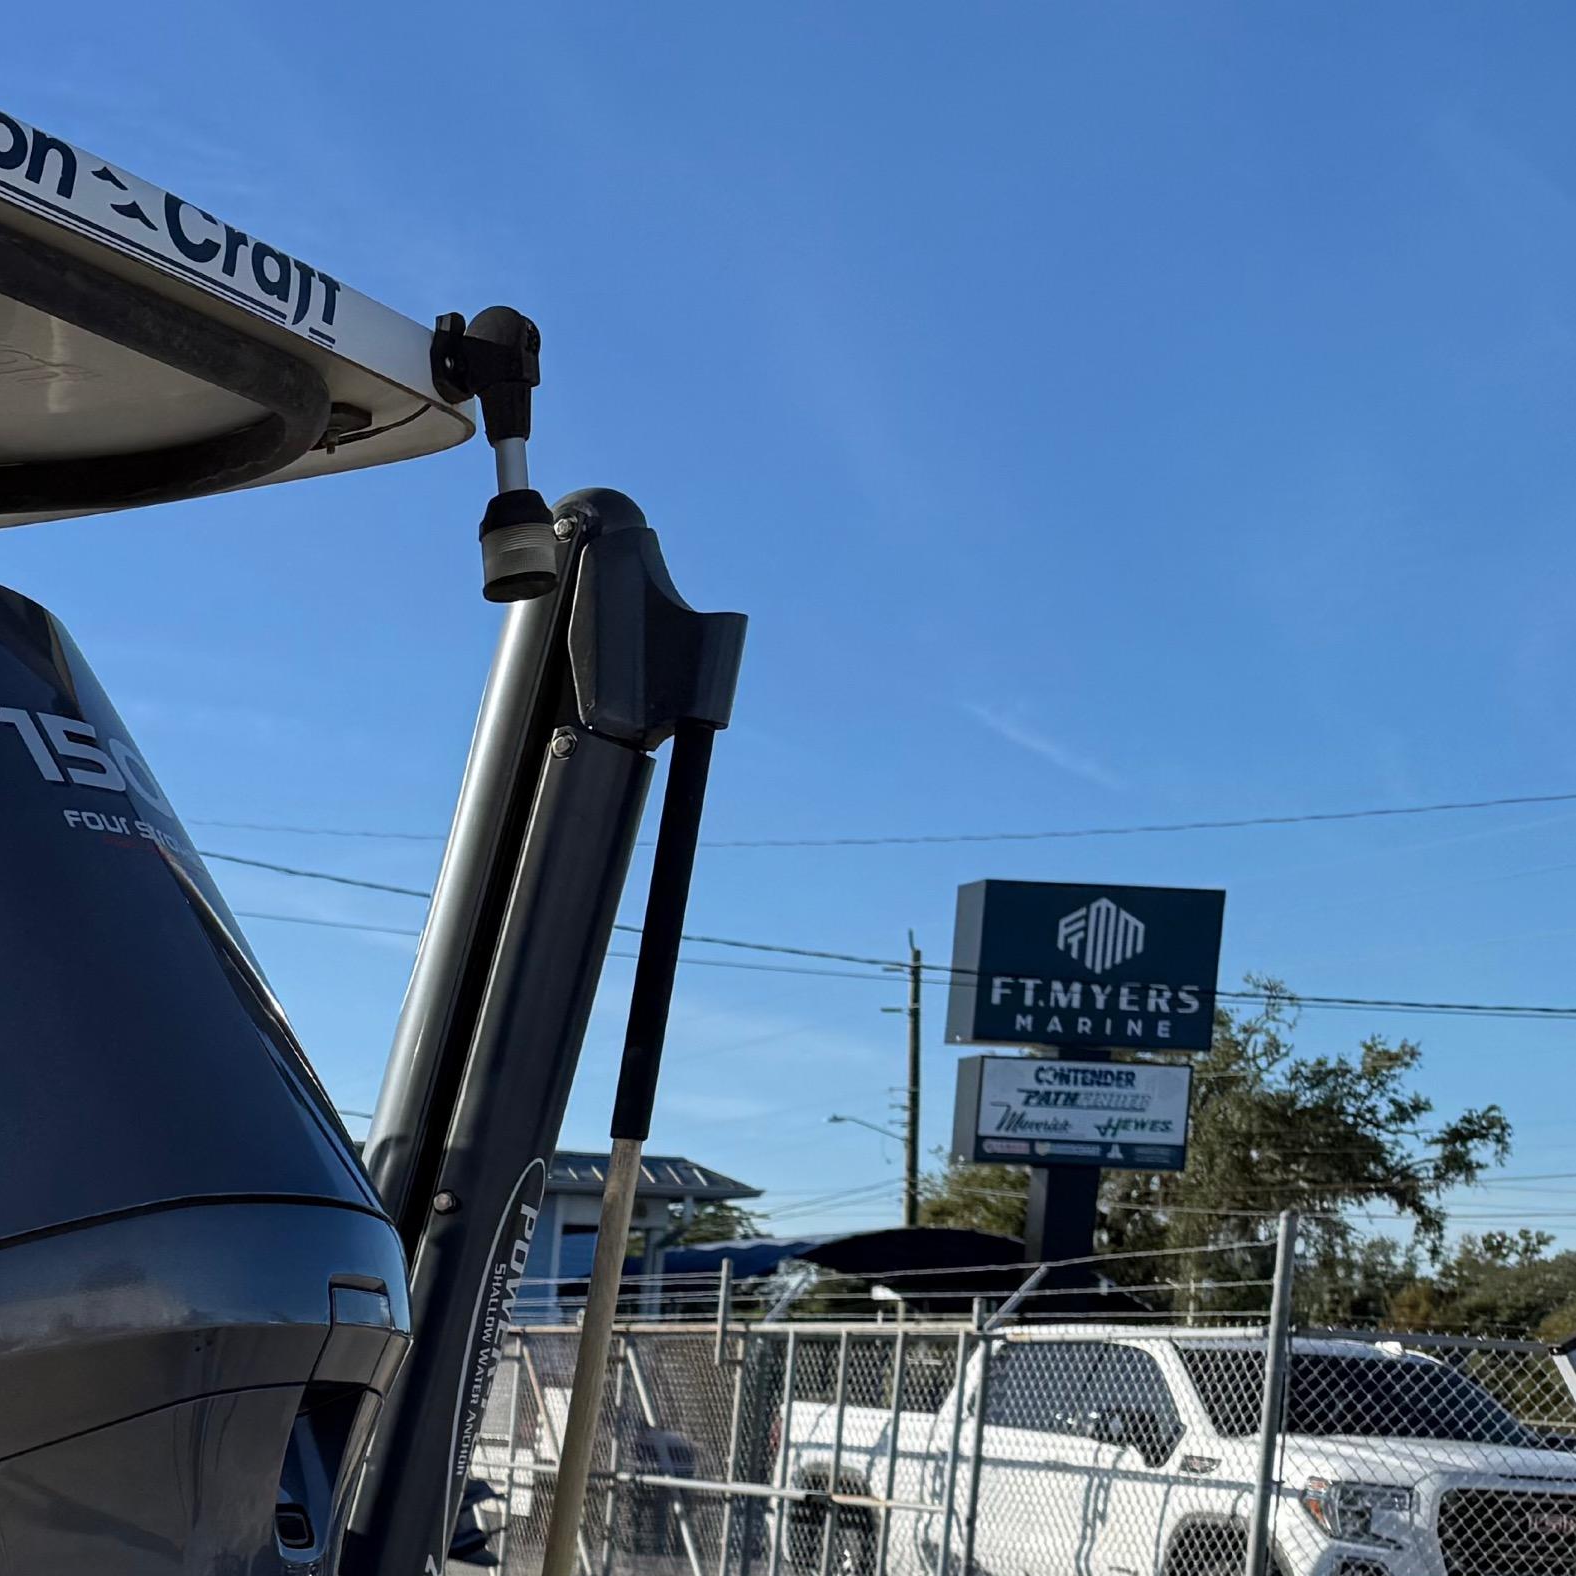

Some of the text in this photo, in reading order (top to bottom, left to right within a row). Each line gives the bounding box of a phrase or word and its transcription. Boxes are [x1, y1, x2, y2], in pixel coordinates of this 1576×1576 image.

[162, 192, 342, 326] Craft
[1015, 1013, 1172, 1039] MARINE
[1034, 1065, 1137, 1089] CONTENDER
[481, 1263, 507, 1343] SHALLOW
[470, 1347, 491, 1405] WATER
